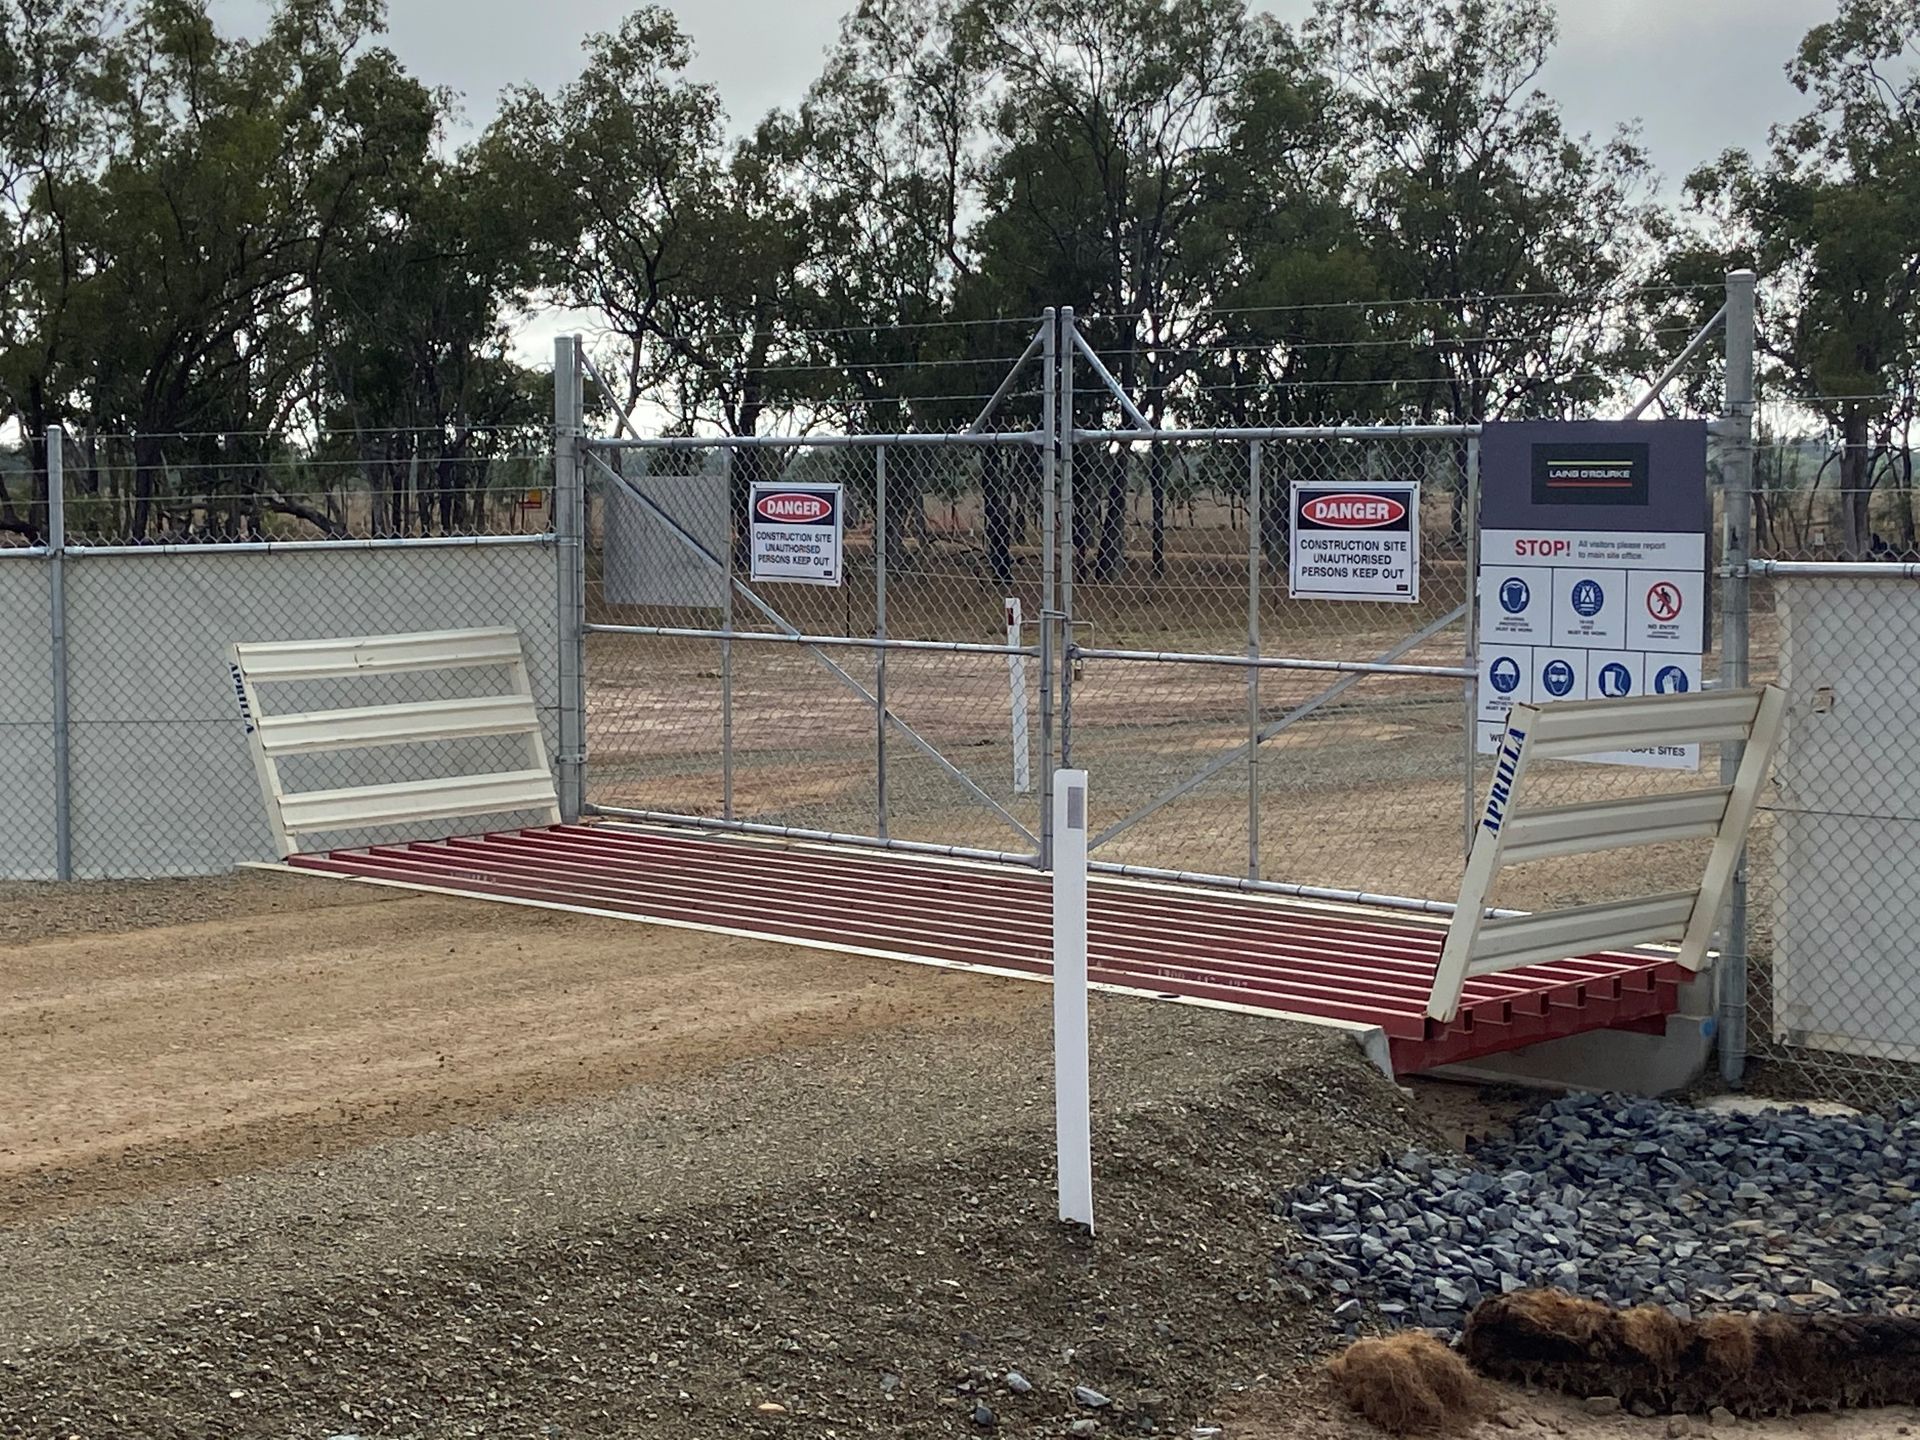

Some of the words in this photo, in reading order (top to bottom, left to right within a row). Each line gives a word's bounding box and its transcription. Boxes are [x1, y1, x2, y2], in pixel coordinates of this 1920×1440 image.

[1549, 470, 1579, 478] LAING
[766, 500, 821, 516] DANGER
[1315, 502, 1390, 520] DANGER
[756, 531, 813, 542] CONSTRUCTION
[814, 533, 832, 543] SITE
[765, 543, 821, 554] UNAUTHORISED
[1300, 539, 1380, 551] CONSTRUCTION
[1383, 541, 1407, 552] SITE
[1515, 539, 1571, 557] STOP!
[758, 554, 791, 565] PERSONS
[792, 556, 812, 565] KEEP
[813, 557, 830, 566] OUT
[1313, 554, 1392, 565] UNAUTHORISED
[1301, 567, 1348, 578] PERSONS
[1352, 568, 1379, 578] KEEP
[1382, 569, 1404, 579] OUT
[1657, 745, 1686, 757] SITES
[1482, 727, 1526, 840] APRILLA
